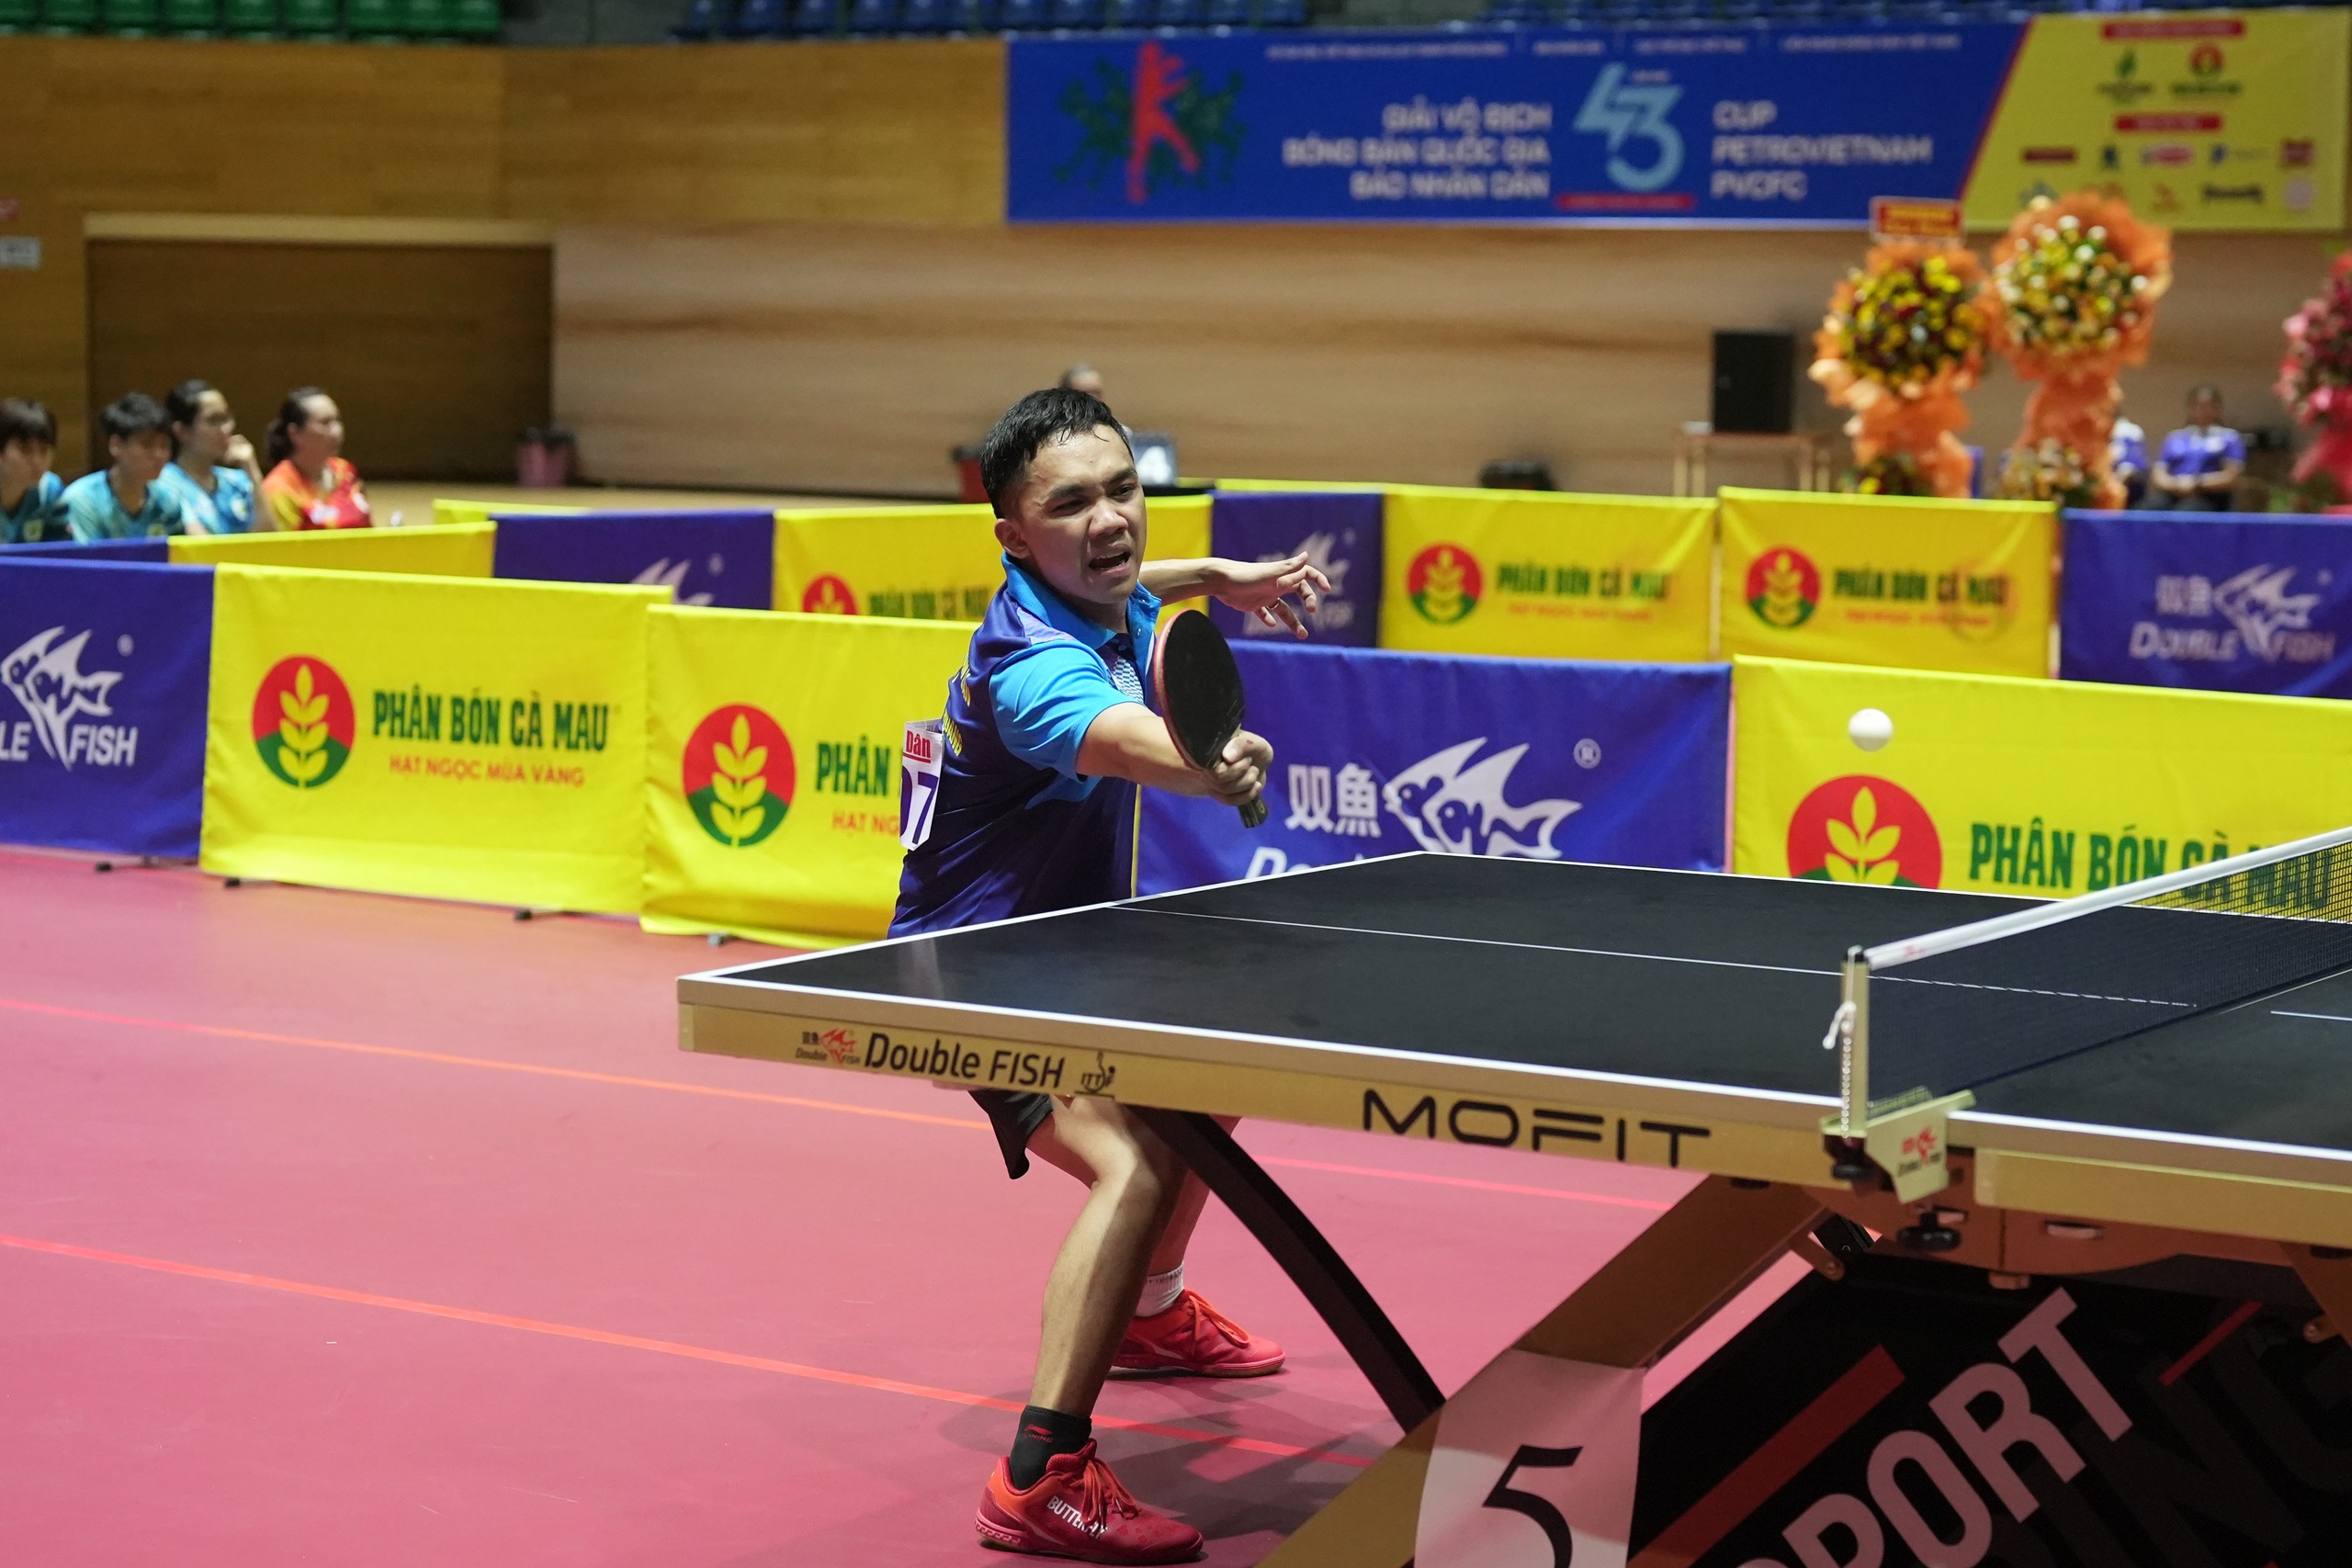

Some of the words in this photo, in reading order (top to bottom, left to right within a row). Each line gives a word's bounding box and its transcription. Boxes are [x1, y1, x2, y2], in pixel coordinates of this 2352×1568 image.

[69, 724, 138, 766] FISH
[372, 683, 442, 741] PHÂN
[449, 687, 502, 746] BÓN
[510, 690, 544, 749] CÀ
[552, 701, 608, 752] MAU
[906, 730, 931, 759] Dân
[816, 734, 890, 796] PHÂN
[1284, 762, 1381, 837] 双魚
[871, 813, 901, 835] NG
[1969, 818, 2075, 889] PHÂN
[2087, 825, 2167, 891] BÓN
[865, 1032, 980, 1078] Double
[989, 1050, 1065, 1089] FISH
[1363, 1089, 1711, 1168] MOFIT
[1736, 1287, 2132, 1568] PORT
[1481, 1444, 1584, 1568] 5
